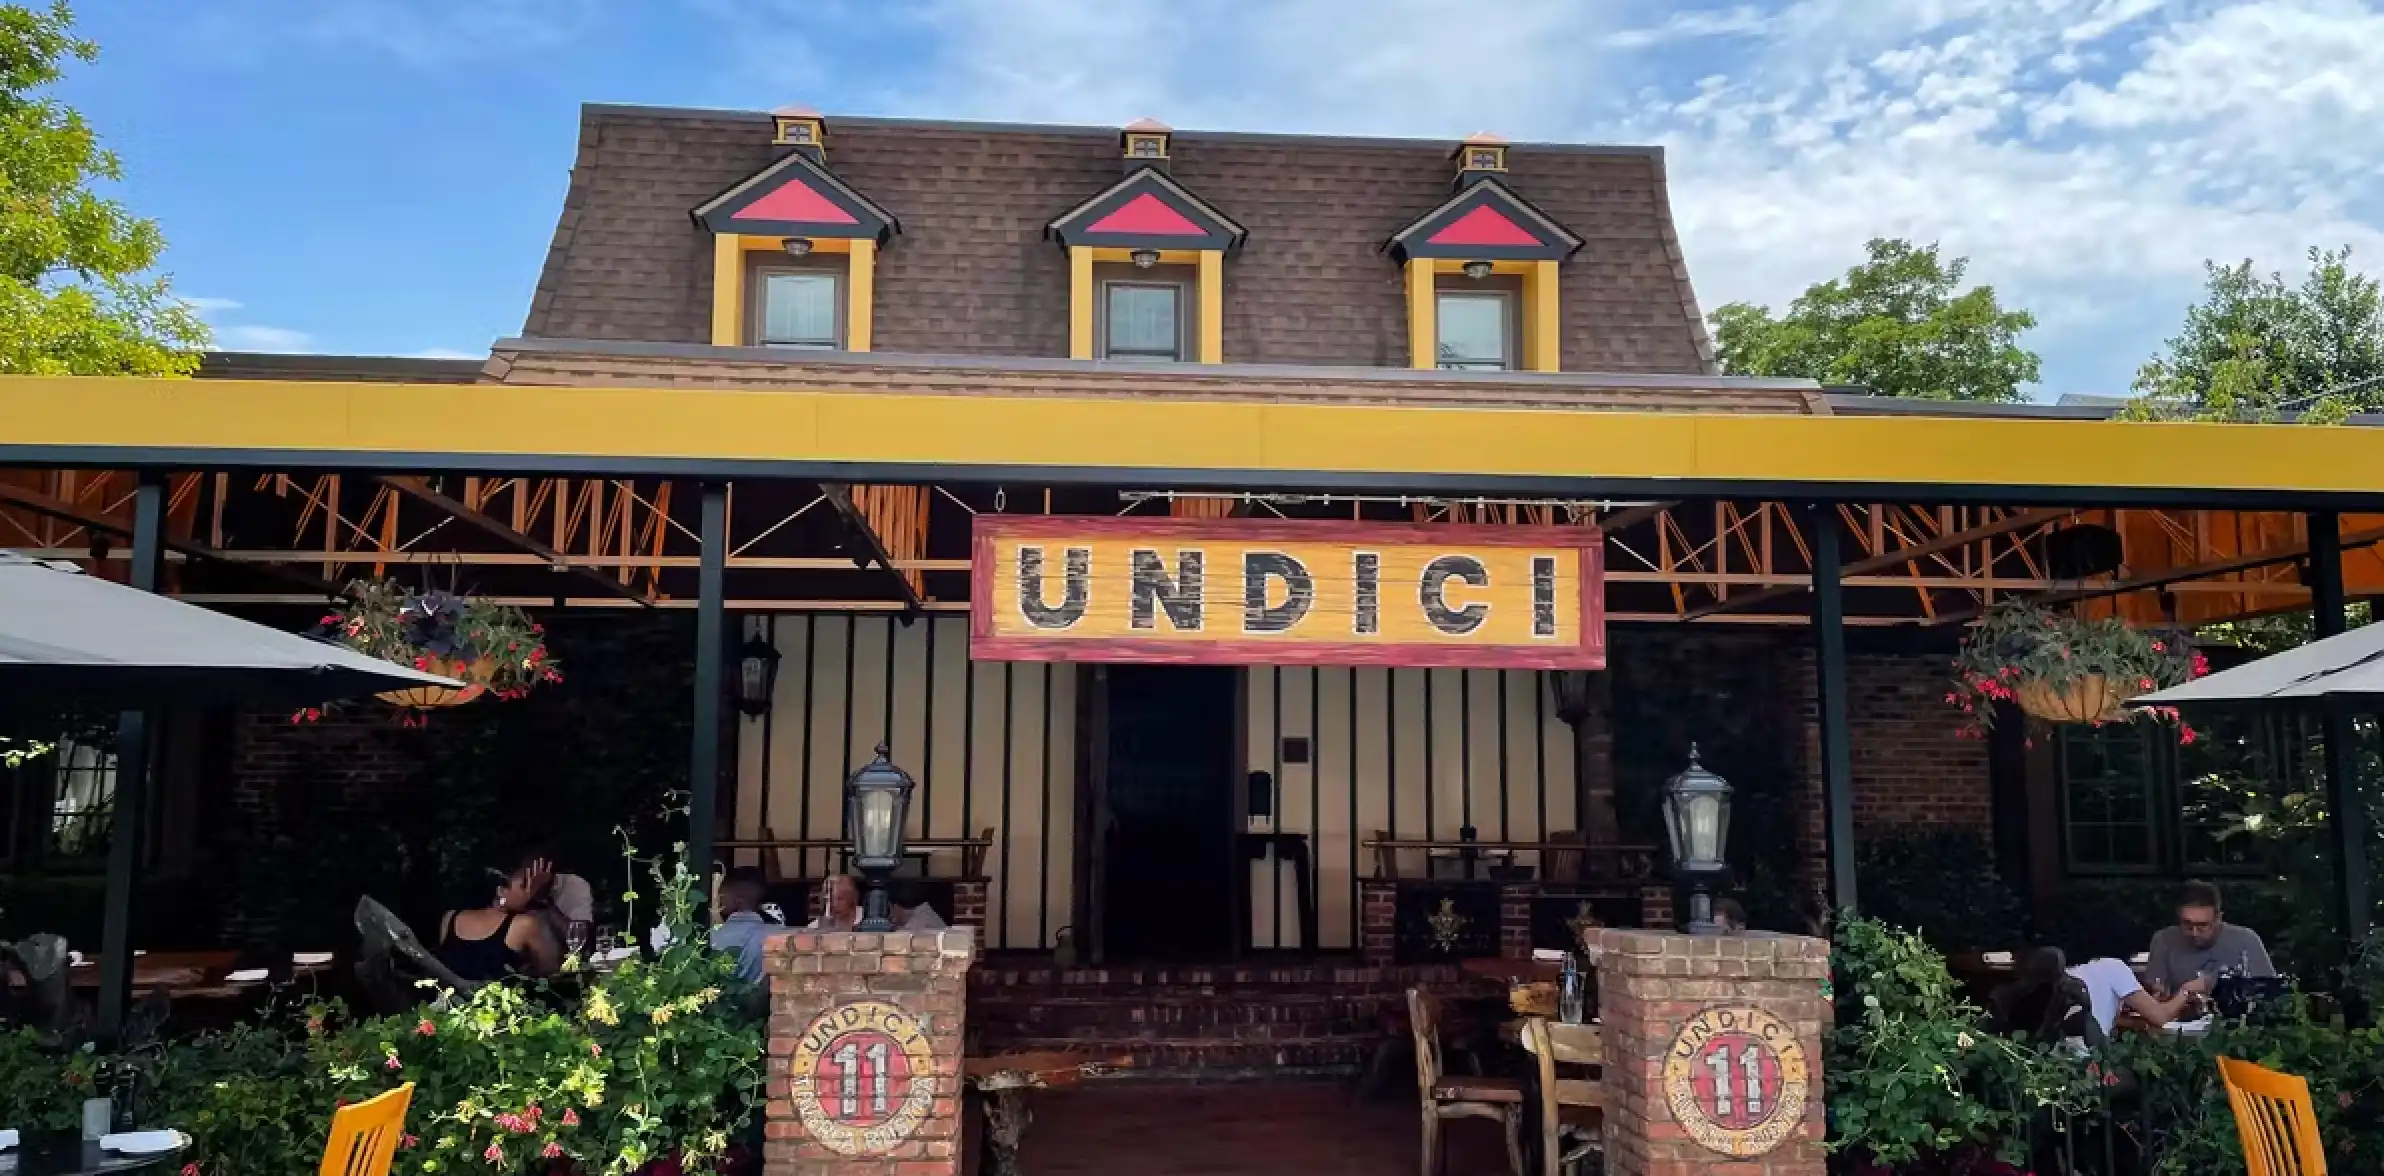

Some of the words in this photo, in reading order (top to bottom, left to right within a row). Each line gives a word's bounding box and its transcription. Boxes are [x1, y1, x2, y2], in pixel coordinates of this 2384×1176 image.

[1017, 543, 1558, 637] UNDICI
[803, 1006, 919, 1053] UNDICI
[1675, 1010, 1793, 1058] UNDICI
[832, 1043, 888, 1119] 11
[1705, 1044, 1763, 1116] 11
